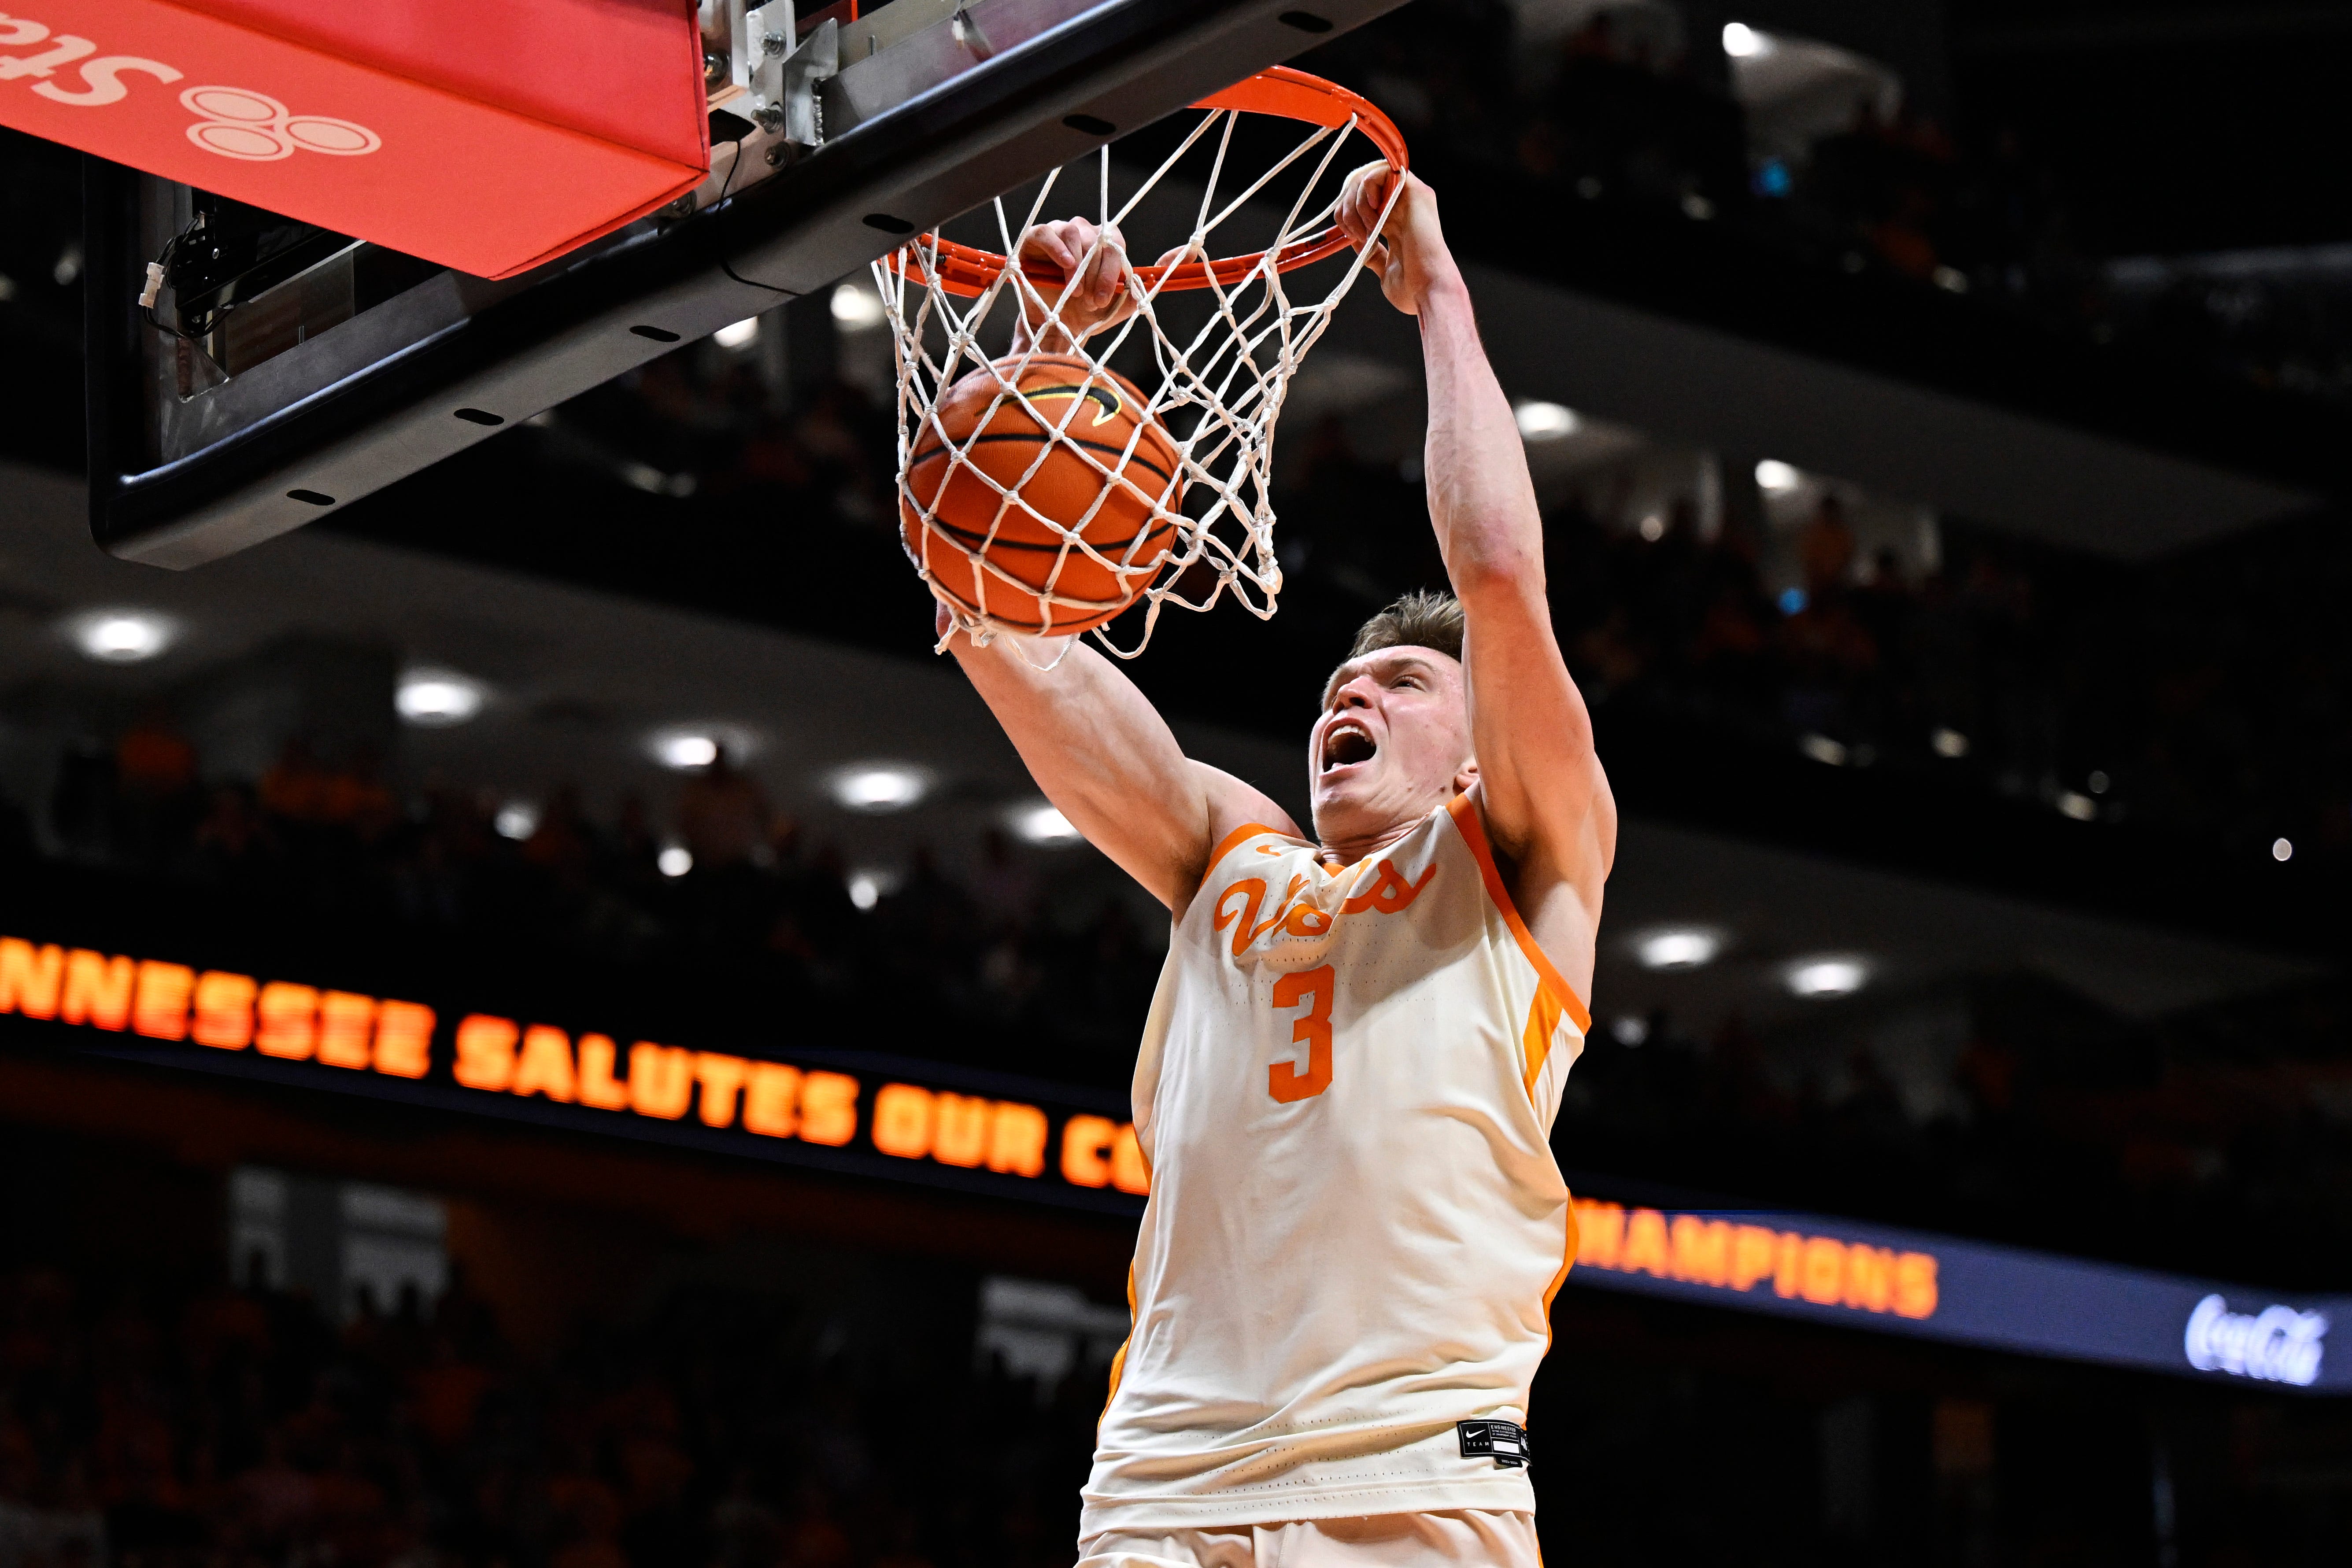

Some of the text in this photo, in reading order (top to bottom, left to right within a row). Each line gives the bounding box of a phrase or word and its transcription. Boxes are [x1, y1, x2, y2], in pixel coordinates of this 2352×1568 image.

[0, 935, 436, 1080] NNESSEE
[453, 1014, 859, 1147] SALUTES
[871, 1083, 1048, 1178] OUR
[1269, 964, 1335, 1103] 3
